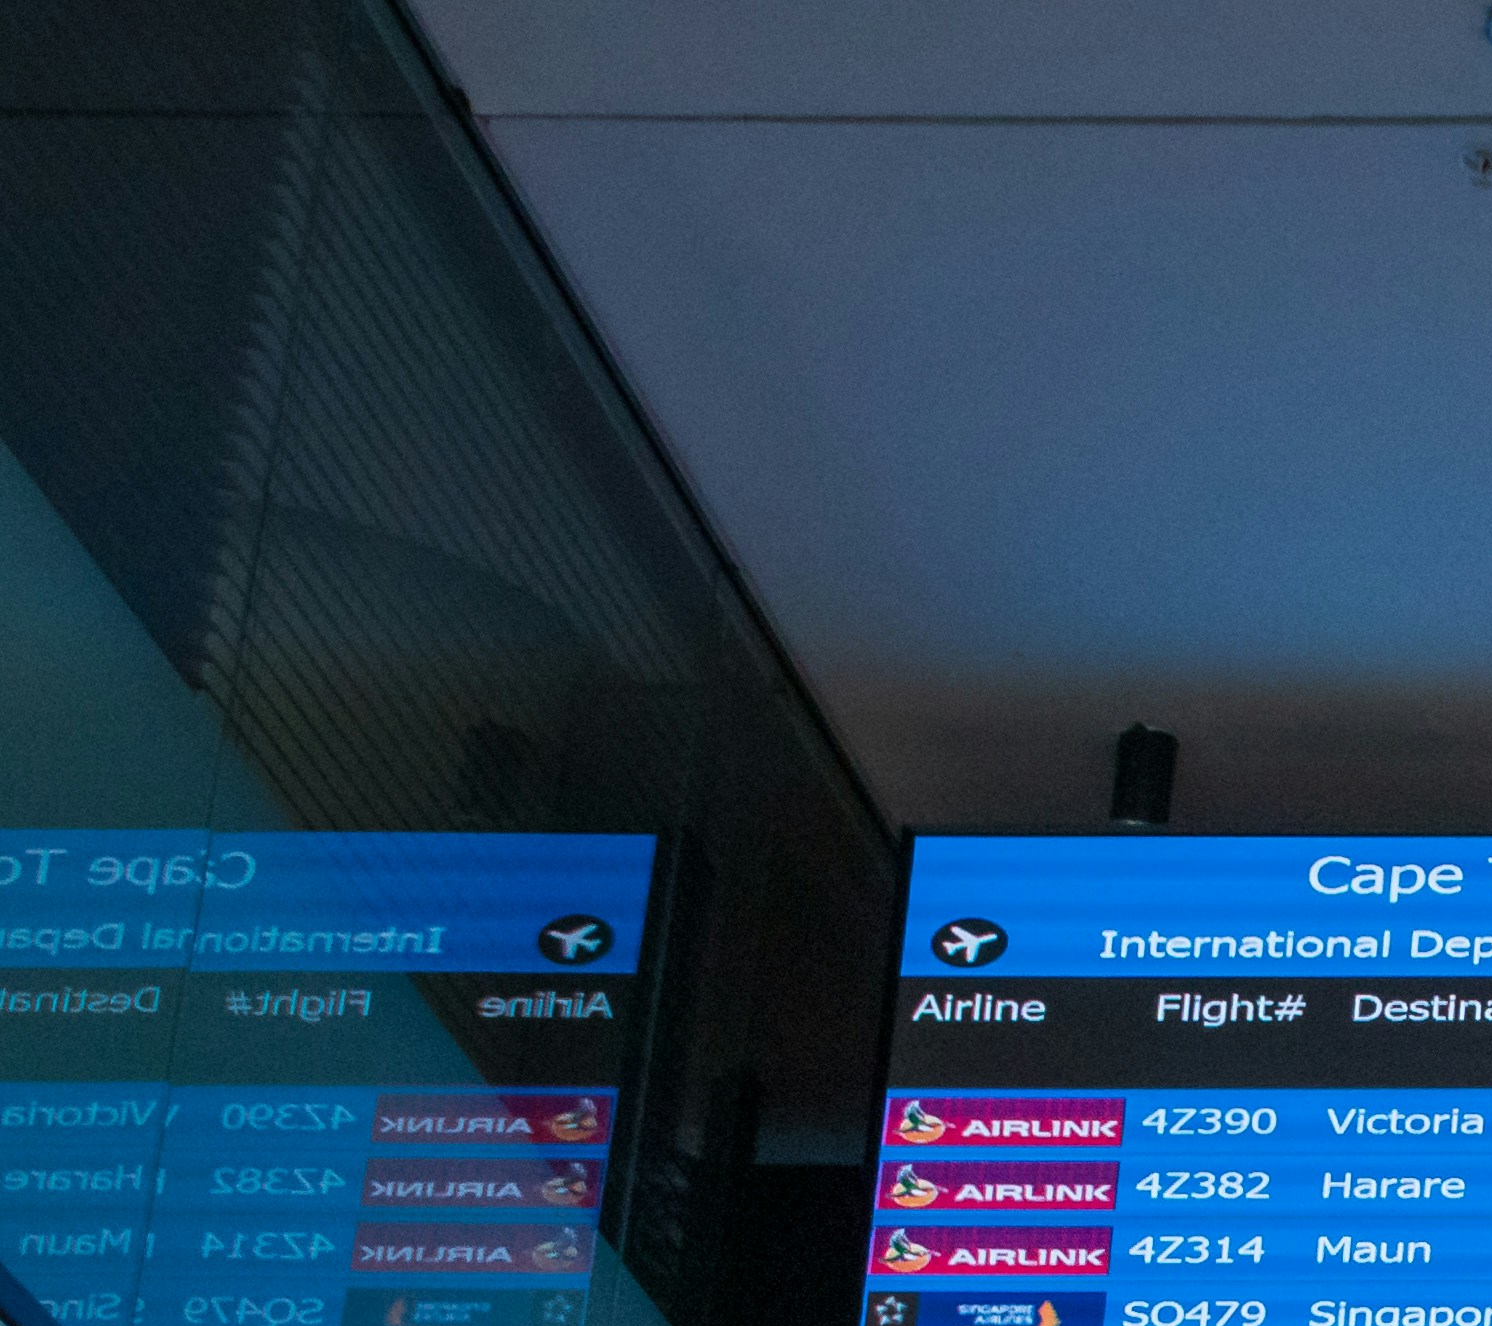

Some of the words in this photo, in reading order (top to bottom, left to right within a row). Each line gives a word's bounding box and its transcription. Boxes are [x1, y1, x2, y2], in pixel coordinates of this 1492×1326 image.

[1310, 856, 1462, 902] Cape
[1100, 931, 1390, 957] International
[913, 994, 1045, 1020] Airline
[1158, 993, 1306, 1025] Flight#
[962, 1117, 1117, 1141] AIRLINK
[1143, 1109, 1276, 1134] 4Z390
[1328, 1109, 1483, 1134] Victoria
